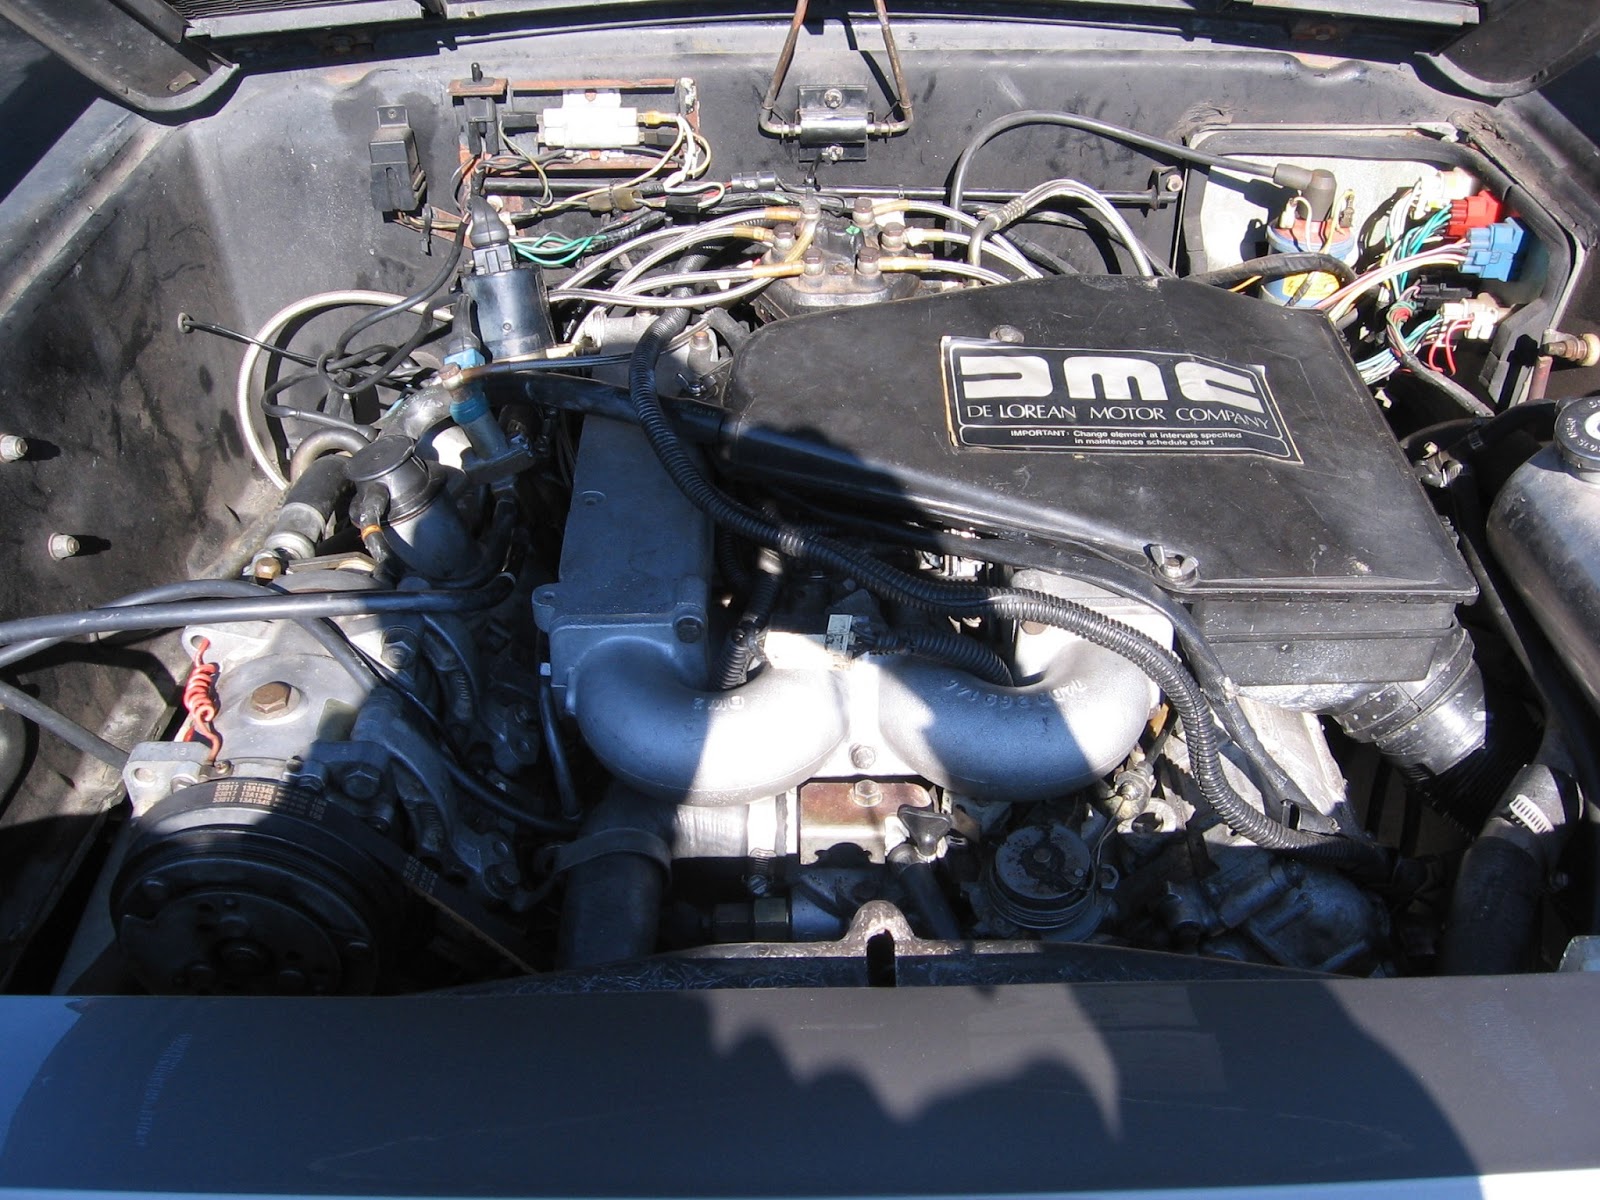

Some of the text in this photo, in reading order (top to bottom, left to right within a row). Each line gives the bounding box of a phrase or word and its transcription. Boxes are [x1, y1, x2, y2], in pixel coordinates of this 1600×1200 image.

[967, 404, 1268, 430] DE LOREAN MOTOR COMPANY
[1073, 430, 1108, 439] Change
[1111, 431, 1148, 439] element
[1160, 431, 1199, 439] intervals
[1200, 431, 1243, 440] specified
[1146, 438, 1188, 446] schedule
